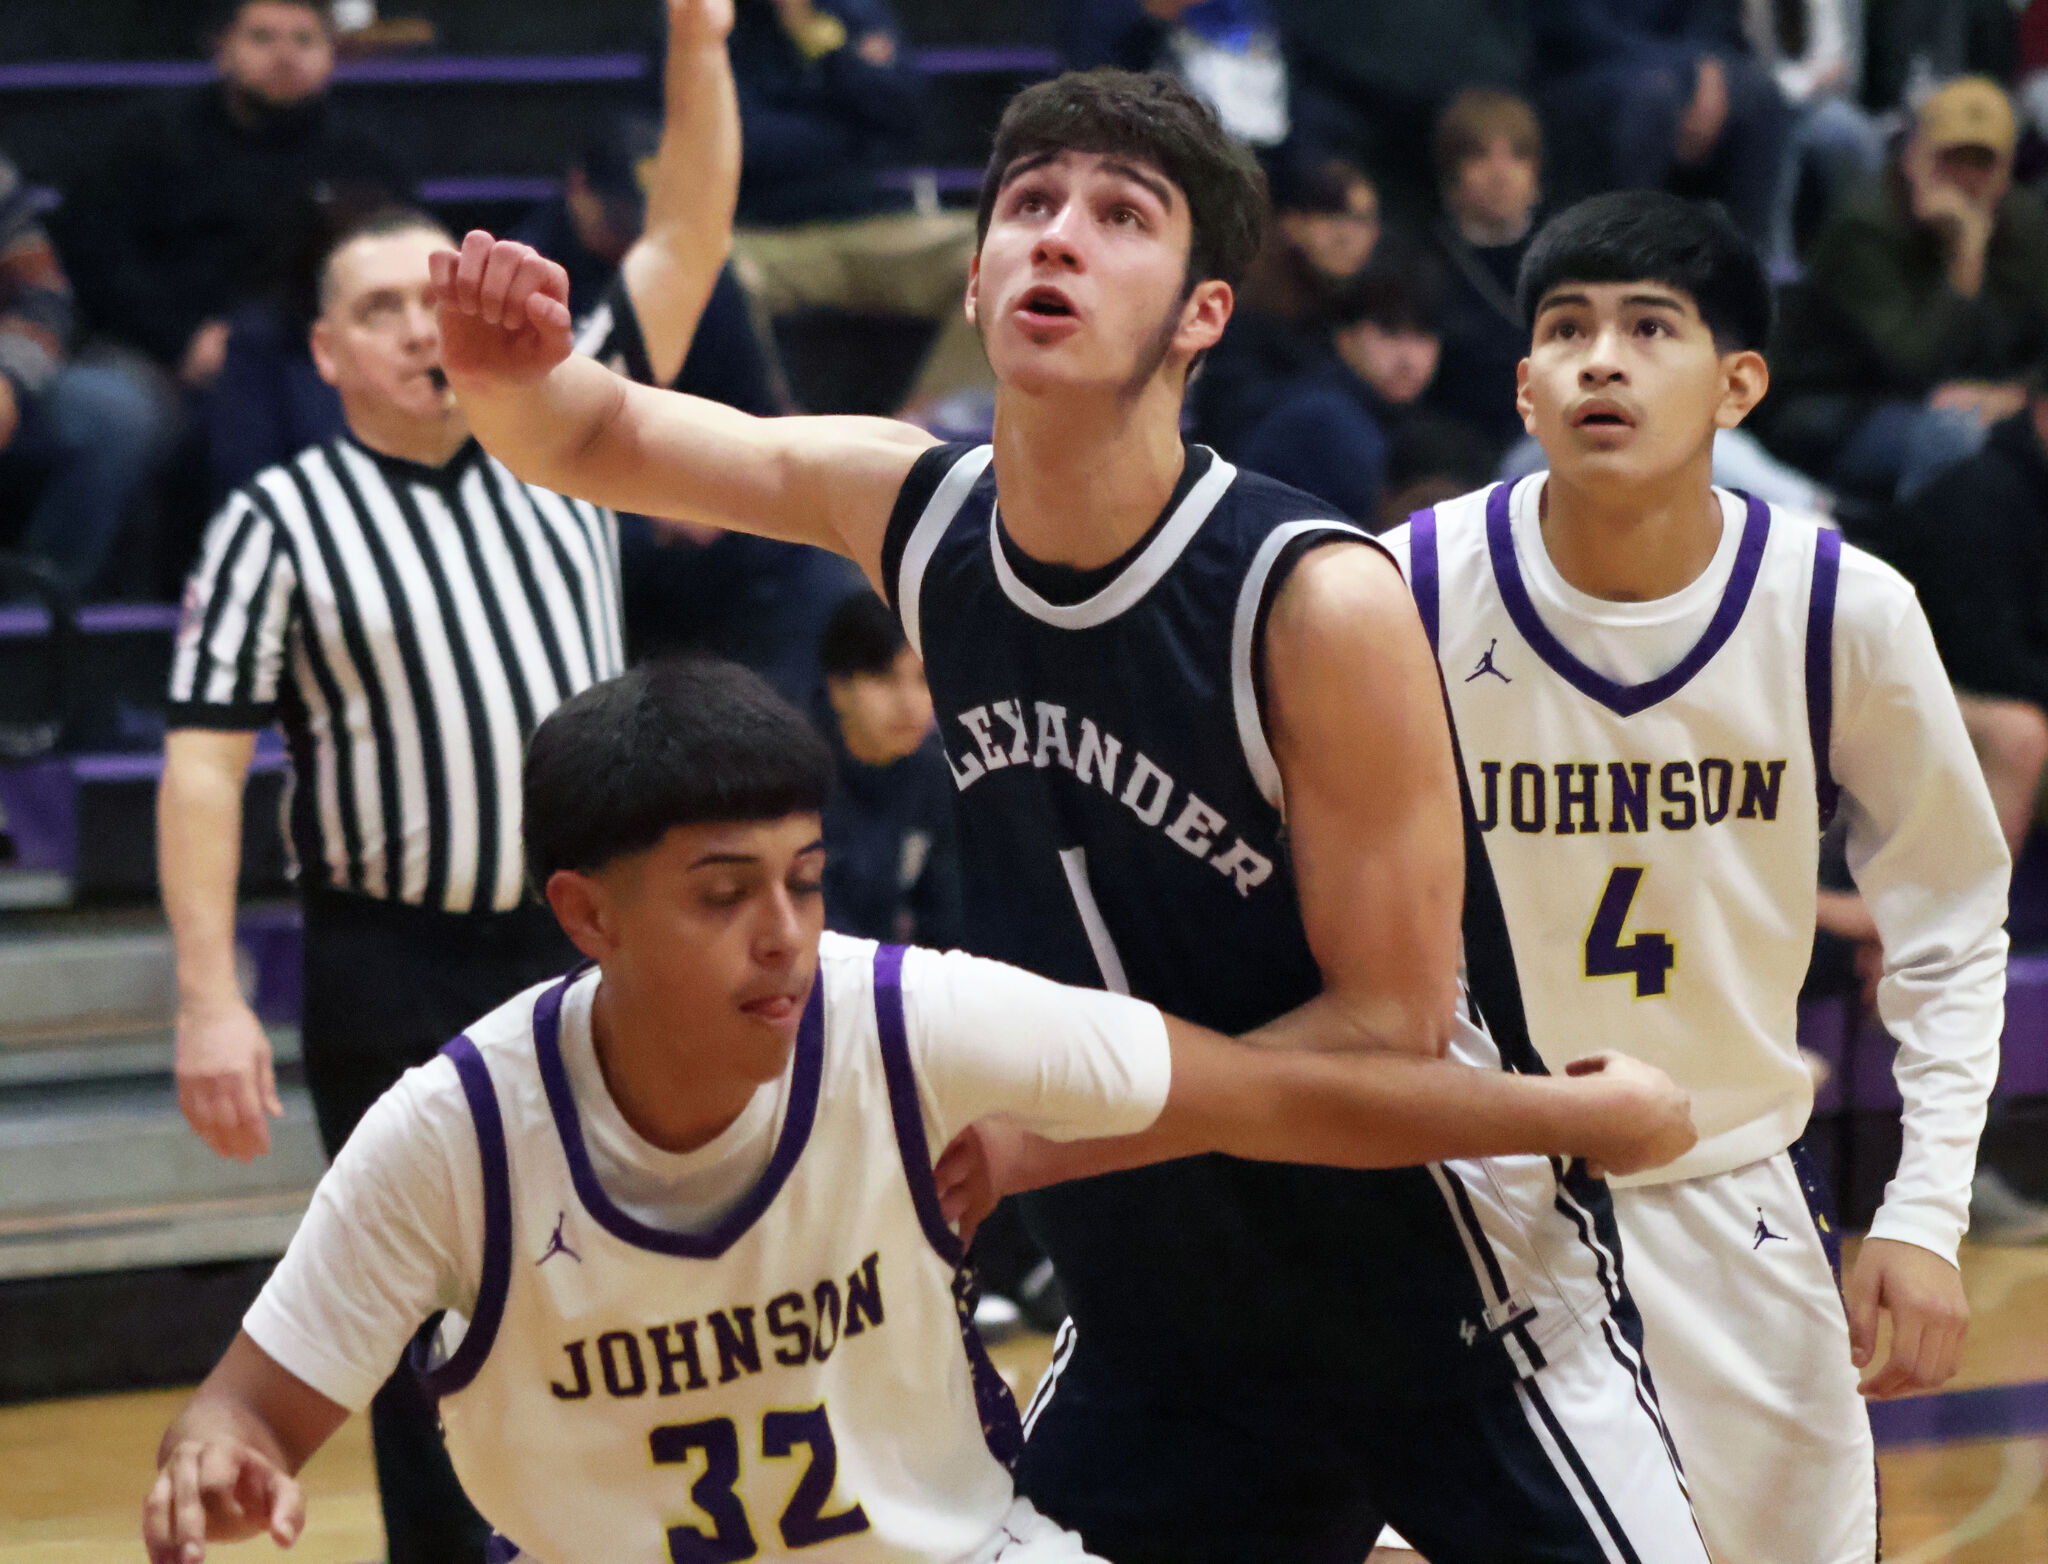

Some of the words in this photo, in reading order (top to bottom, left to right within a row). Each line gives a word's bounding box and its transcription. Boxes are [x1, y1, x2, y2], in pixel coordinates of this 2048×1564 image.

[942, 697, 1274, 898] LEXANDER
[1476, 757, 1788, 835] JOHNSON
[1580, 863, 1678, 1001] 4
[550, 1250, 885, 1400] JOHNSON
[649, 1401, 872, 1564] 32
